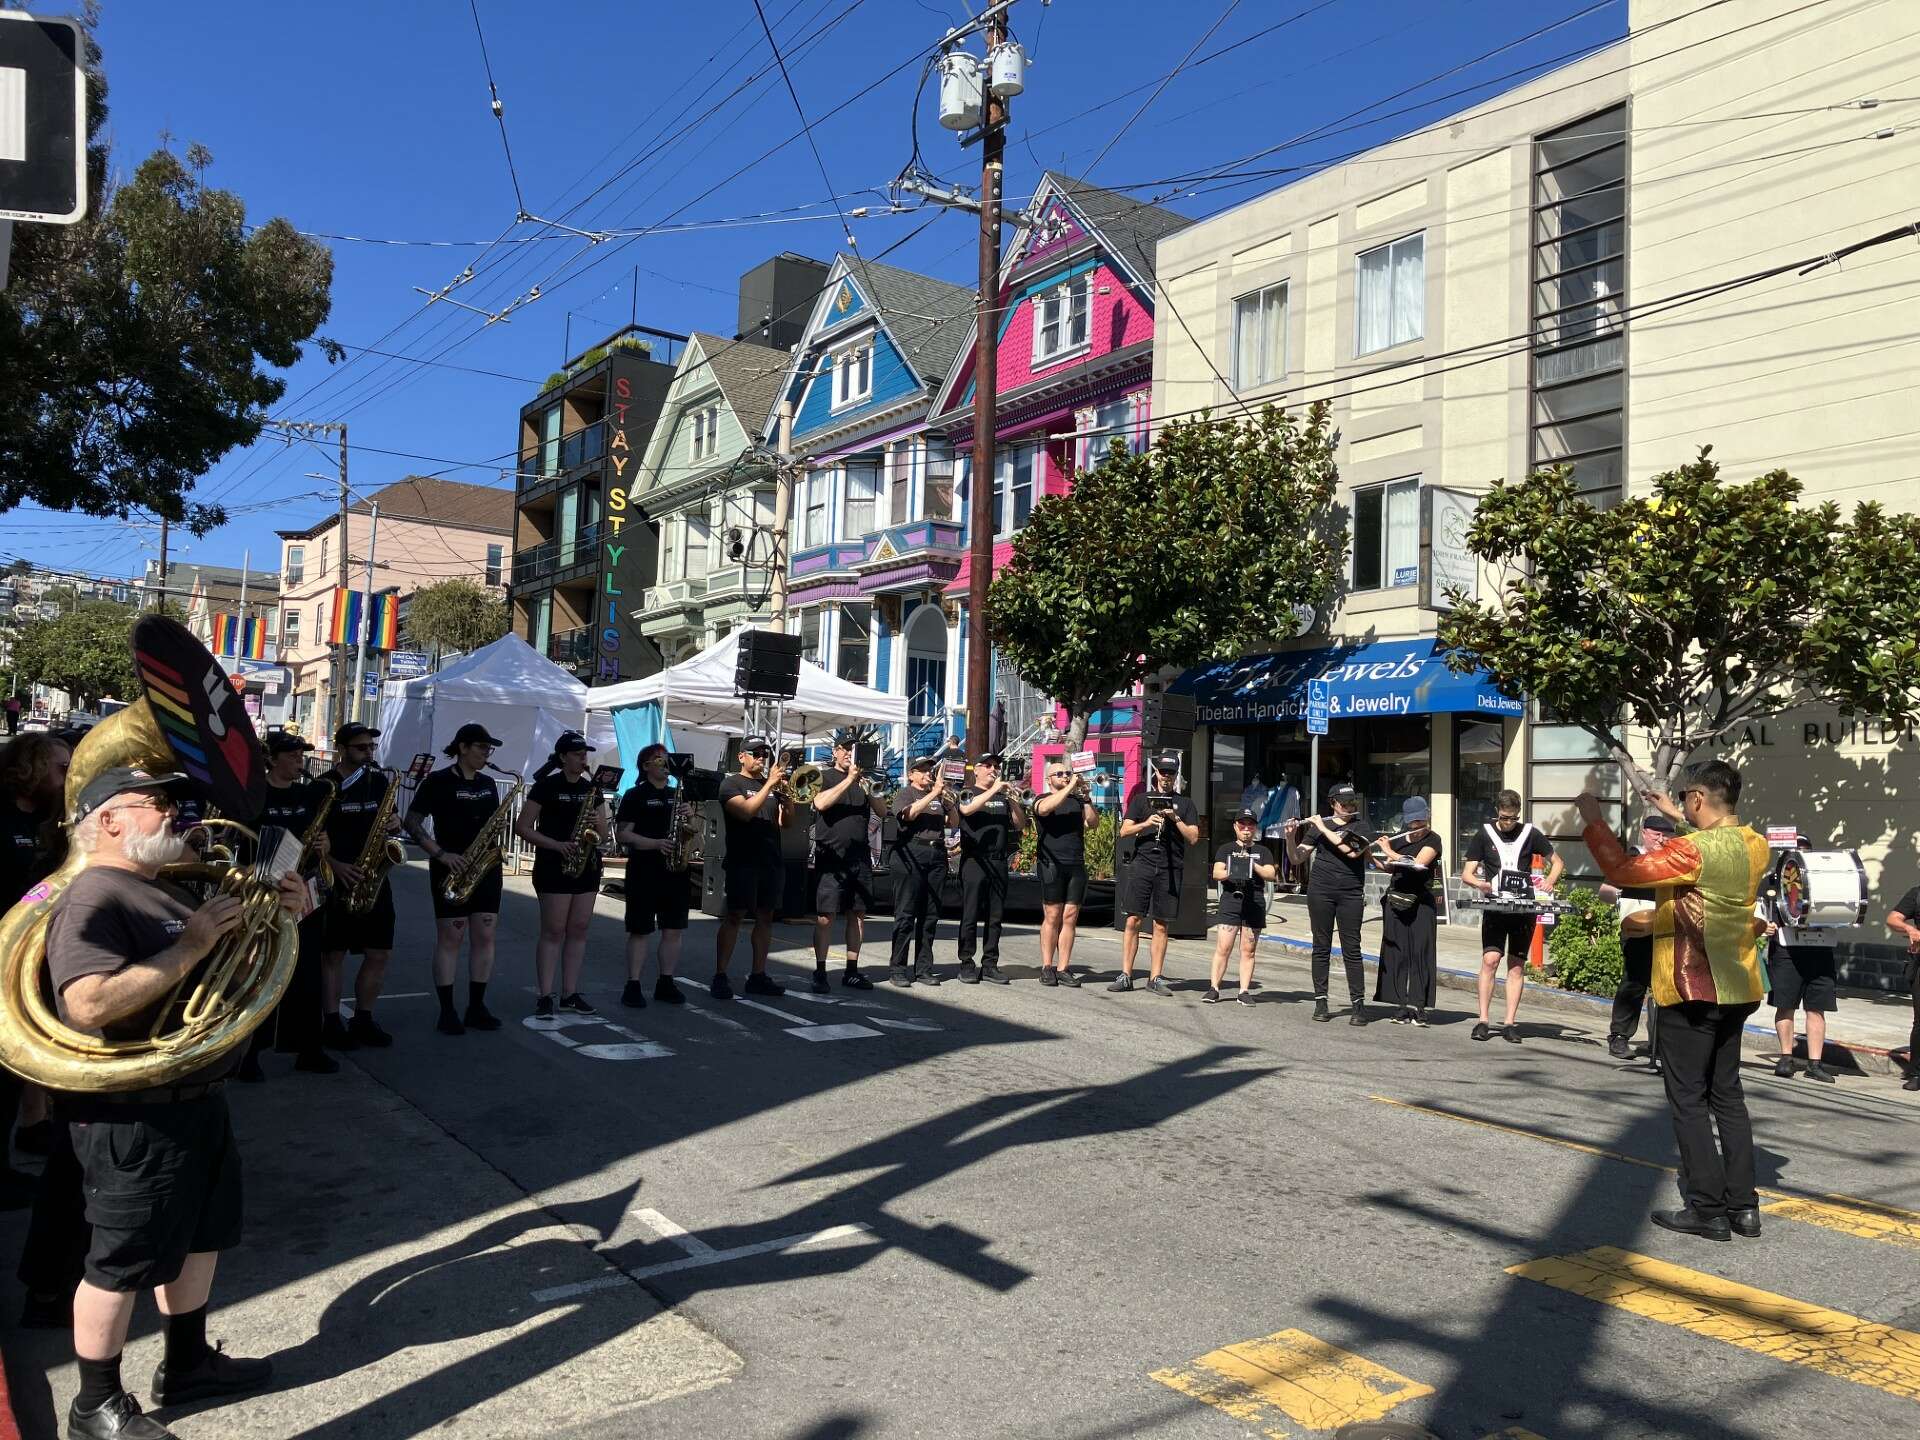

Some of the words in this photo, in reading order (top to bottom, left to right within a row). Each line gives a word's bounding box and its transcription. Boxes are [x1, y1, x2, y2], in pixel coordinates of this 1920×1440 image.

[612, 377, 630, 477] STAY
[600, 487, 627, 681] STYLISH
[1396, 569, 1417, 579] LURIE
[1308, 652, 1427, 686] Jewels
[1195, 704, 1243, 721] Tibetan
[1247, 699, 1309, 718] Handicra
[1330, 695, 1341, 714] &
[1346, 692, 1411, 714] Jewelry
[1477, 694, 1497, 708] Deki
[1497, 696, 1522, 710] Jewels
[1646, 722, 1774, 751] MEICAL
